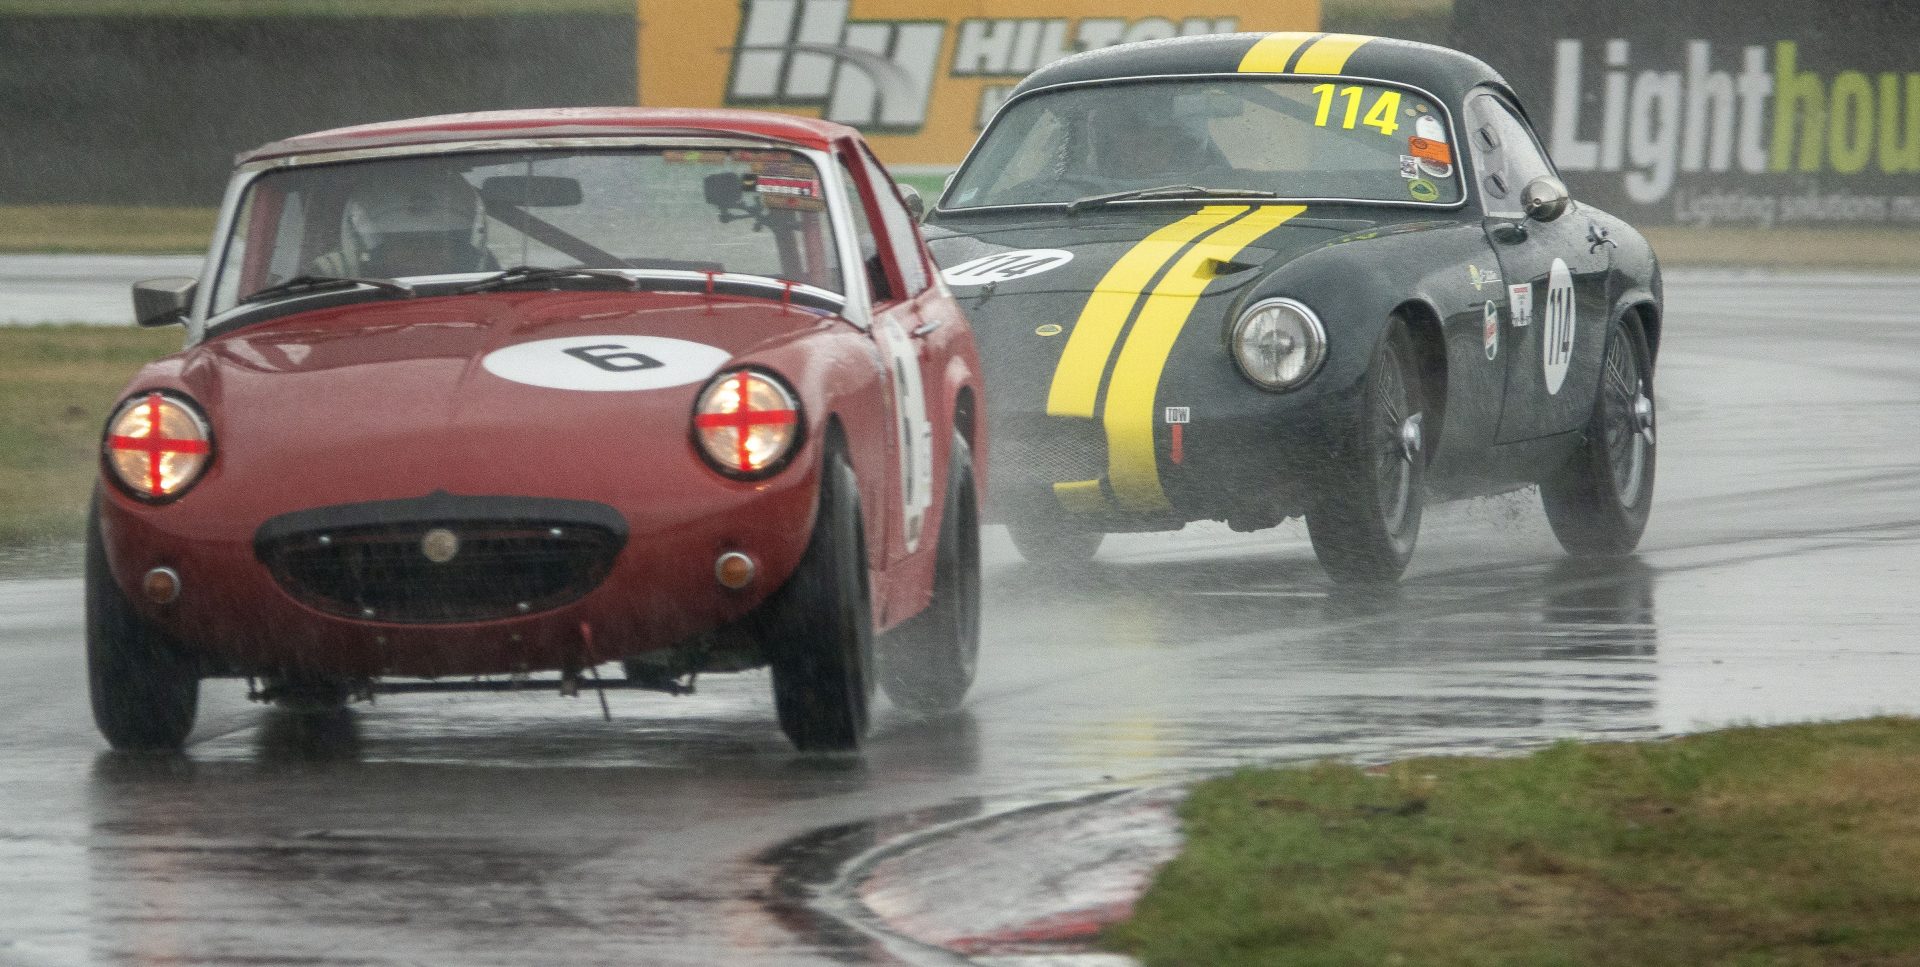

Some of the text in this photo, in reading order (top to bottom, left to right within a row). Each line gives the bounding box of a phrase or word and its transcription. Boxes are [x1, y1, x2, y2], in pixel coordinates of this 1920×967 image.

[1312, 83, 1402, 136] 114
[1552, 38, 1920, 203] Lighthou
[951, 254, 1063, 278] 114
[1548, 287, 1572, 366] 114
[560, 344, 667, 372] 6
